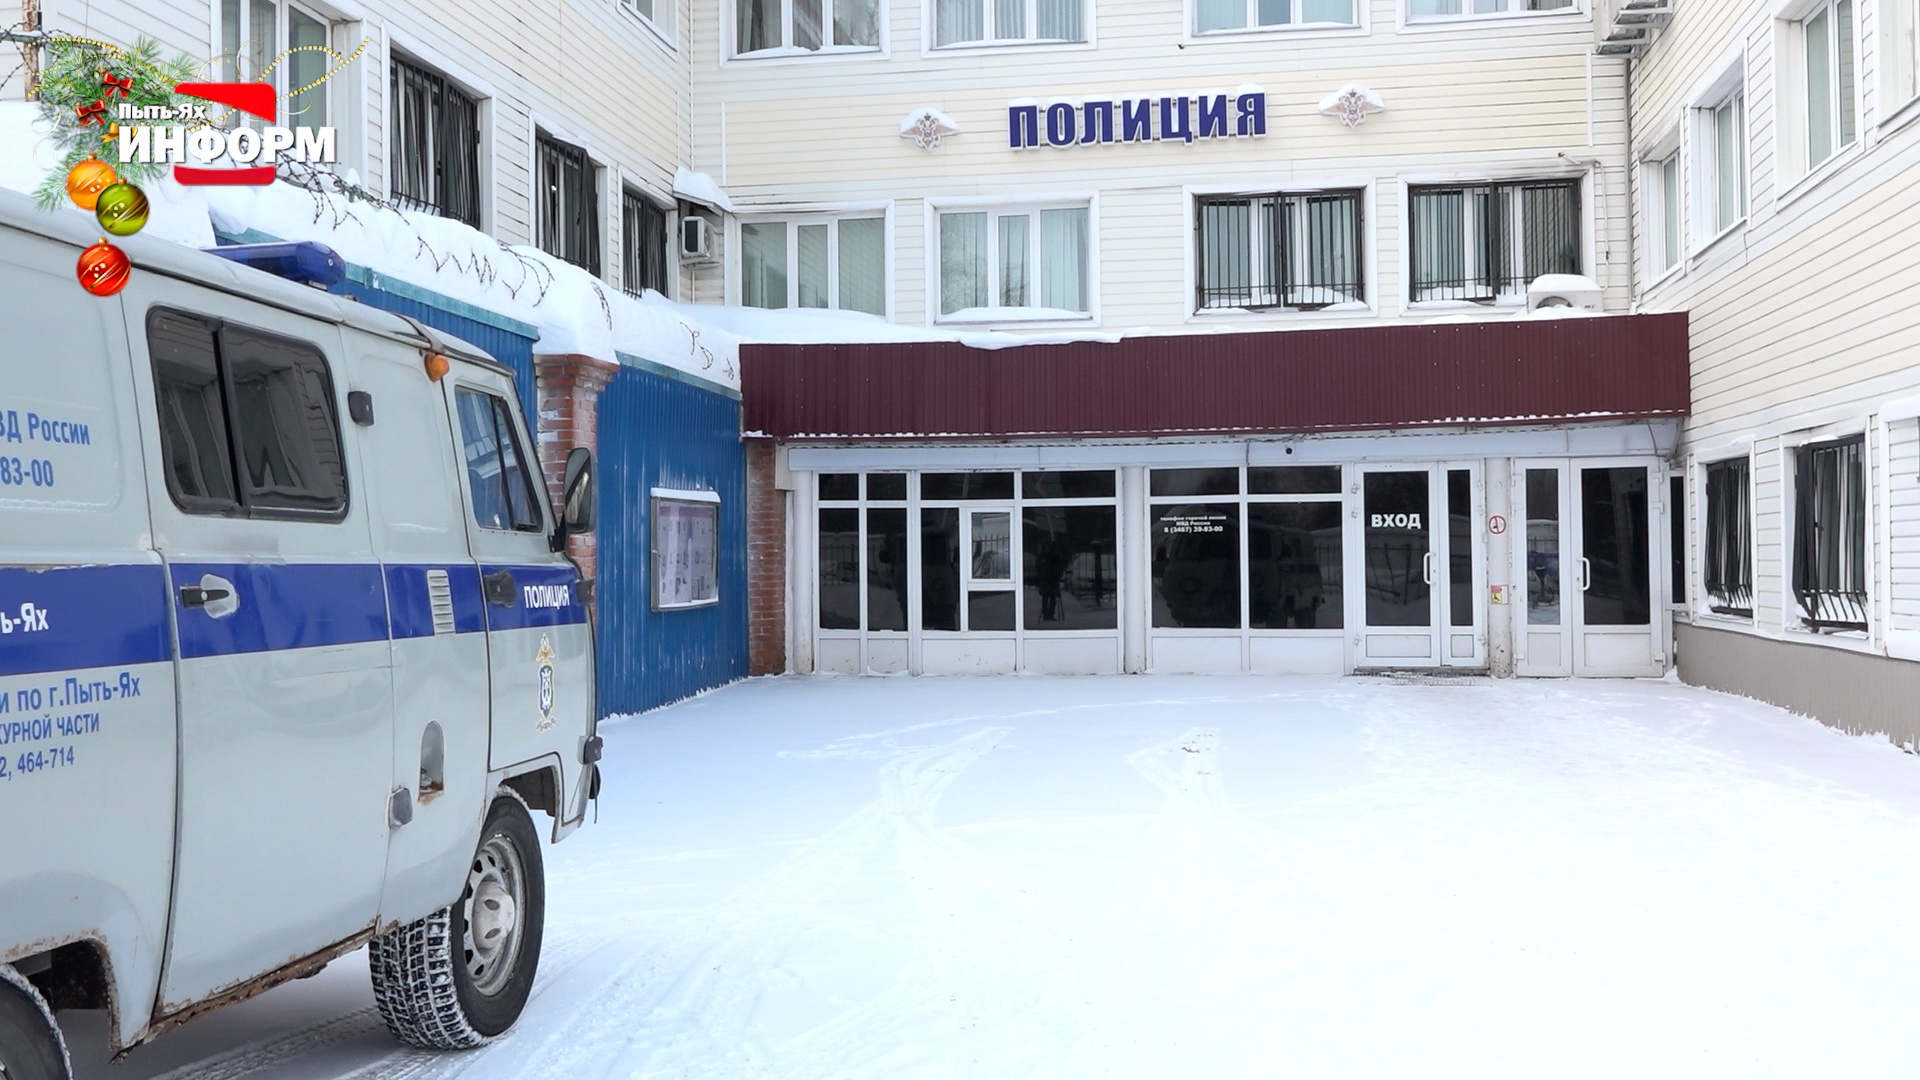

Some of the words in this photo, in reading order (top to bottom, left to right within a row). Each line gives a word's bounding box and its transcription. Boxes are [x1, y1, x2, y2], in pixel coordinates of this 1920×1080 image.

[1008, 92, 1268, 149] ПОЛИЦИЯ
[27, 412, 90, 445] России
[0, 456, 54, 487] 83-00
[1371, 513, 1421, 530] ВХОД
[523, 584, 570, 610] ПОЛИЦИЯ
[56, 713, 100, 737] ЧАСТИ
[17, 745, 75, 774] 464-714
